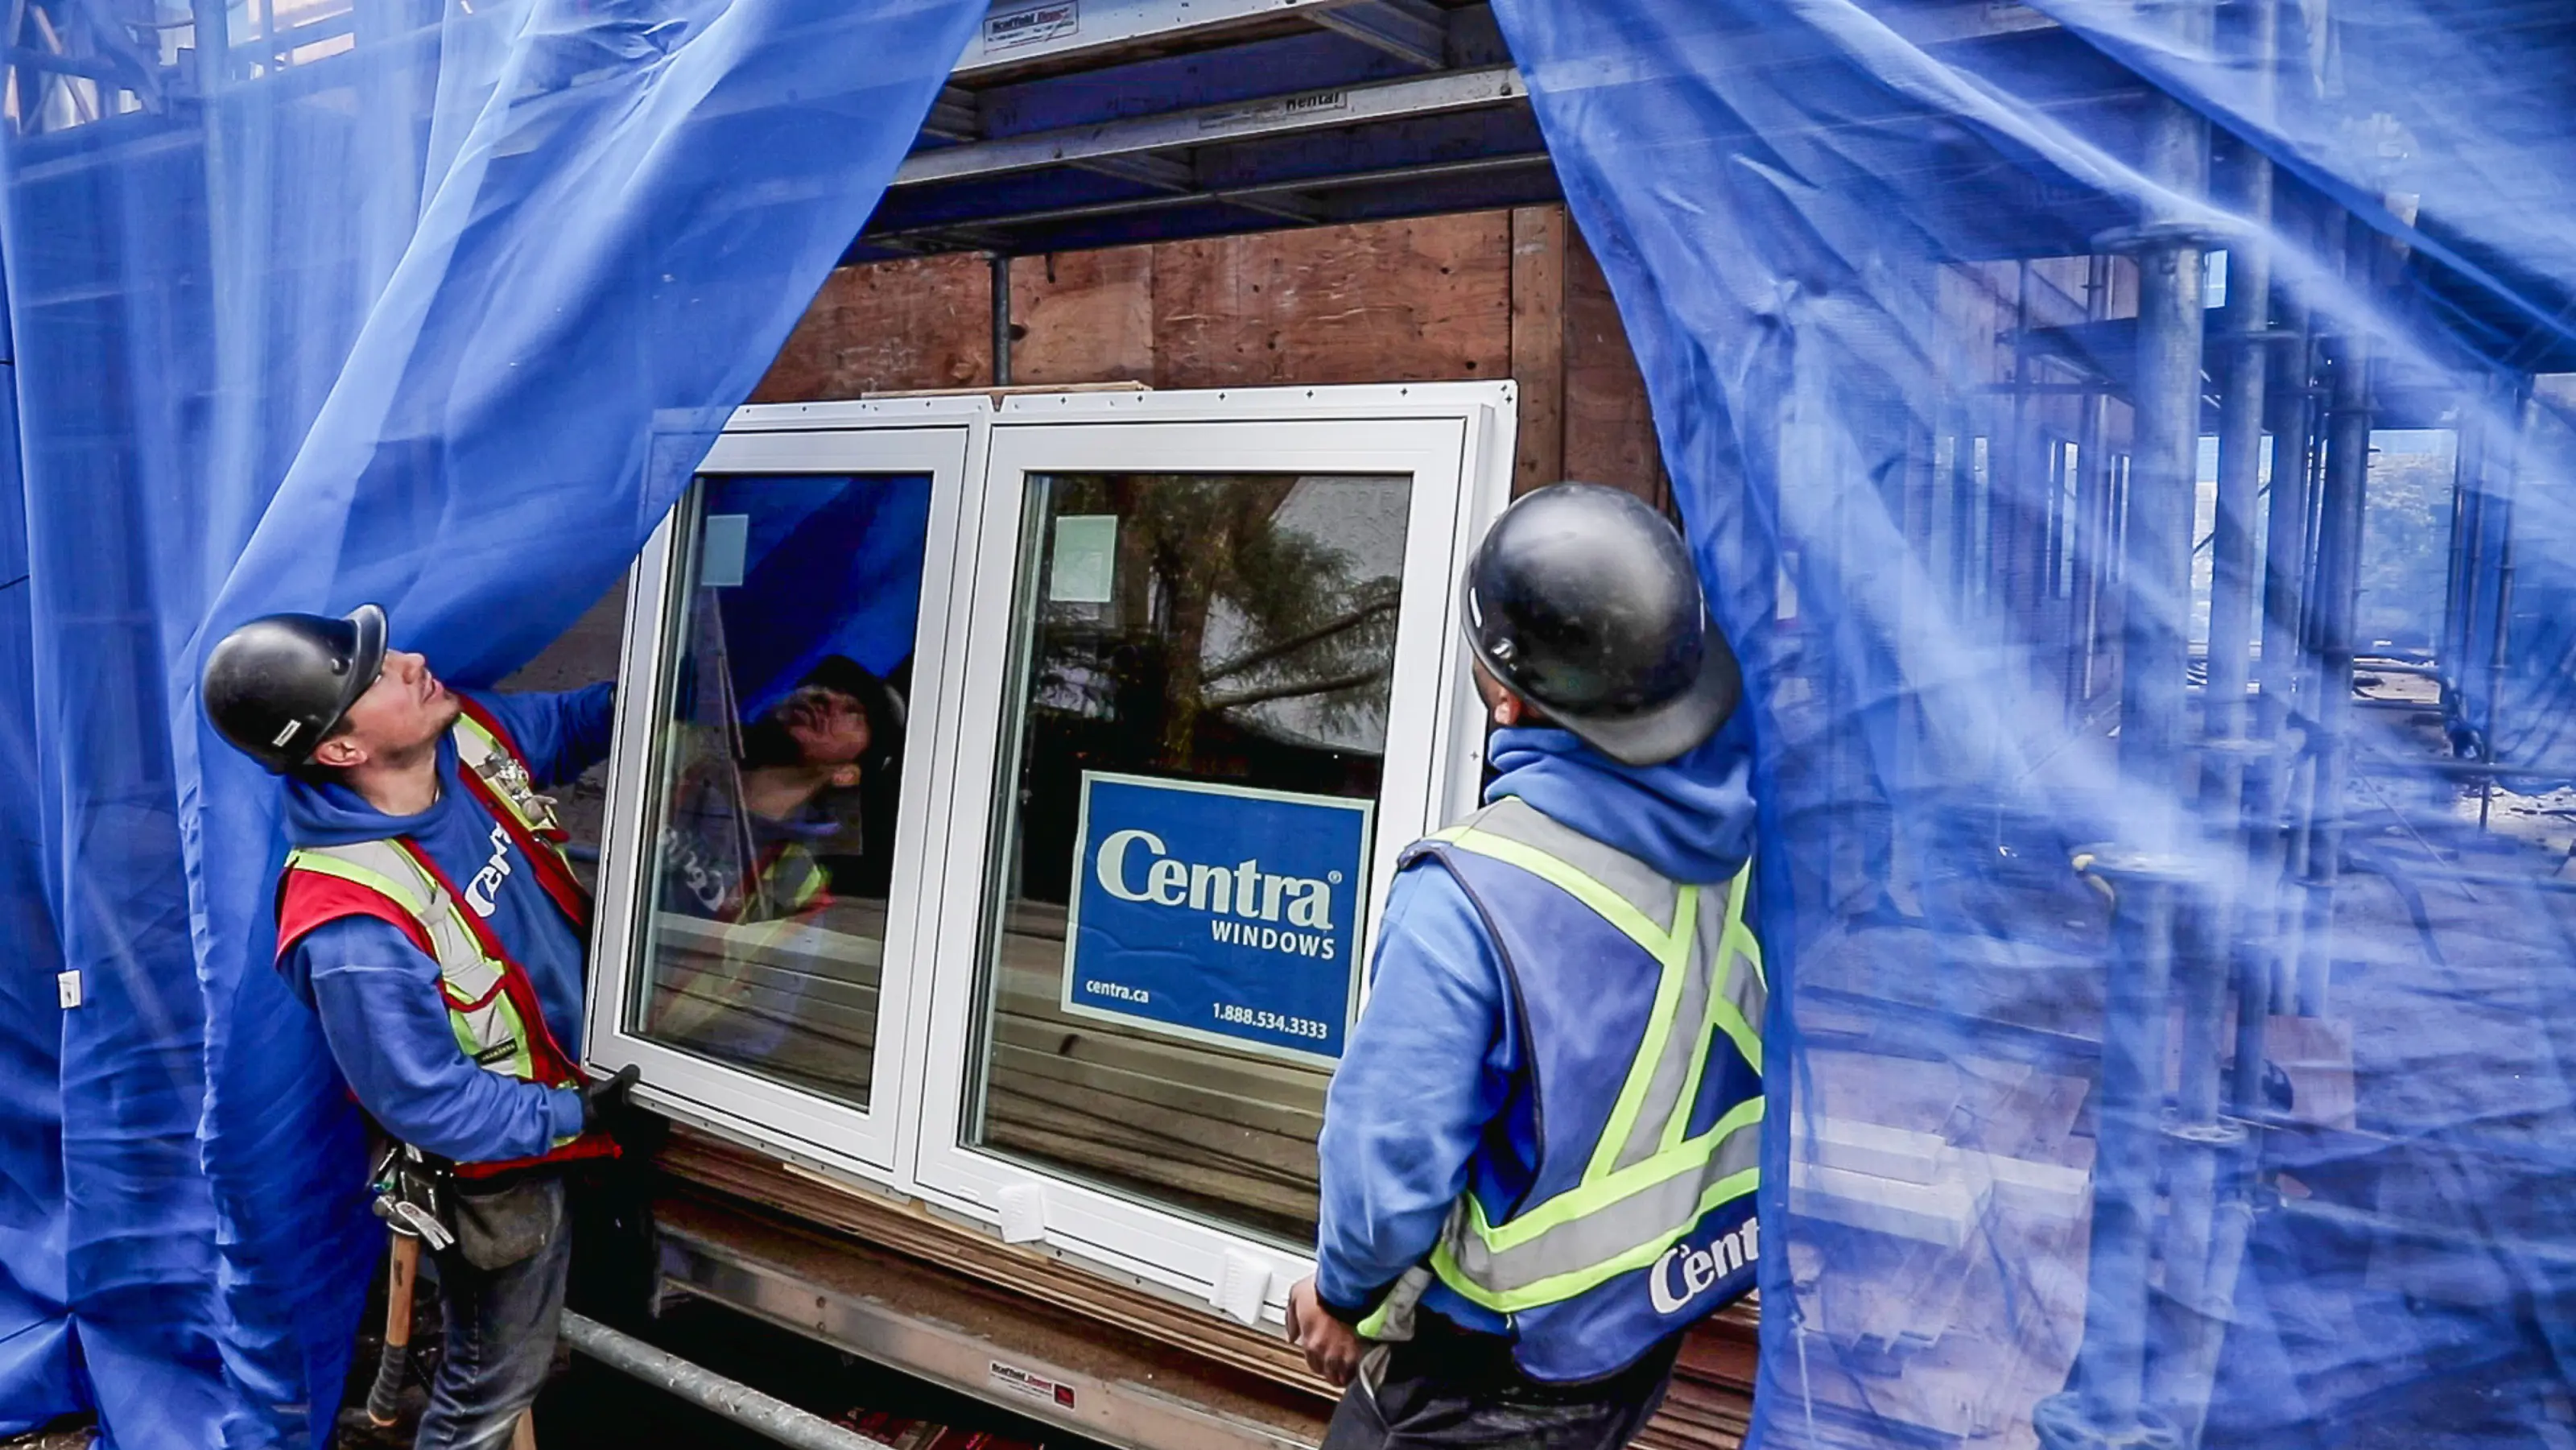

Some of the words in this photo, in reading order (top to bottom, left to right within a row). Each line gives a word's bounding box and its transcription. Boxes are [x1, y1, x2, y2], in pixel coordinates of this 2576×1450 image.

[1212, 919, 1335, 960] WINDOWS
[1086, 979, 1150, 1004] centra.ca
[1213, 1002, 1327, 1039] 1.888.534.3333
[1649, 1217, 1760, 1314] Cent
